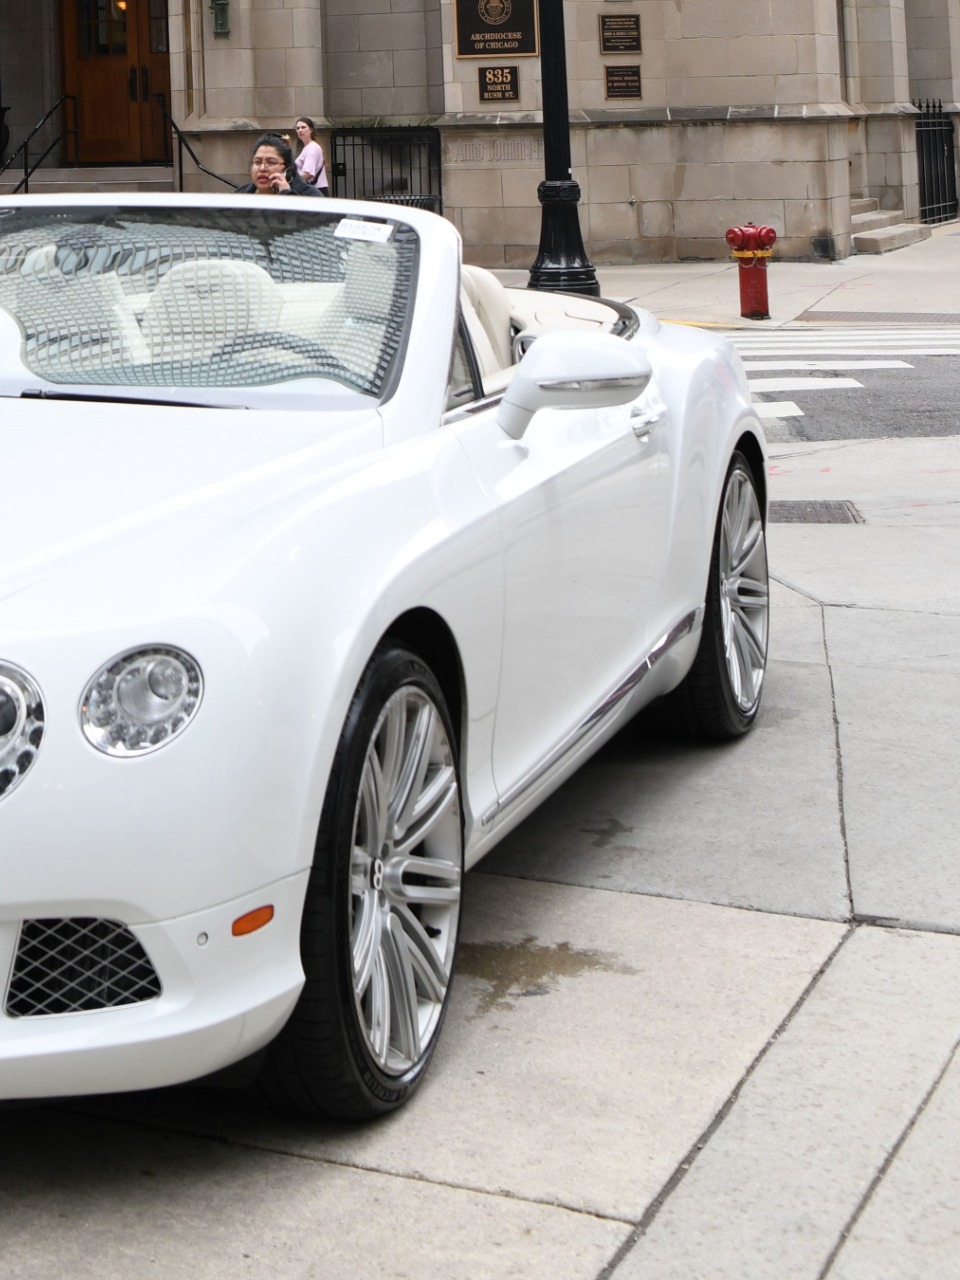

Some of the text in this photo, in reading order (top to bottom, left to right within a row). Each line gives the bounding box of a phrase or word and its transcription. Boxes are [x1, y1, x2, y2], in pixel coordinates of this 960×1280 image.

[470, 32, 522, 41] ARCHDIOCESE
[474, 41, 519, 50] OF CHICAGO
[485, 68, 511, 84] 835
[504, 91, 515, 99] ST.
